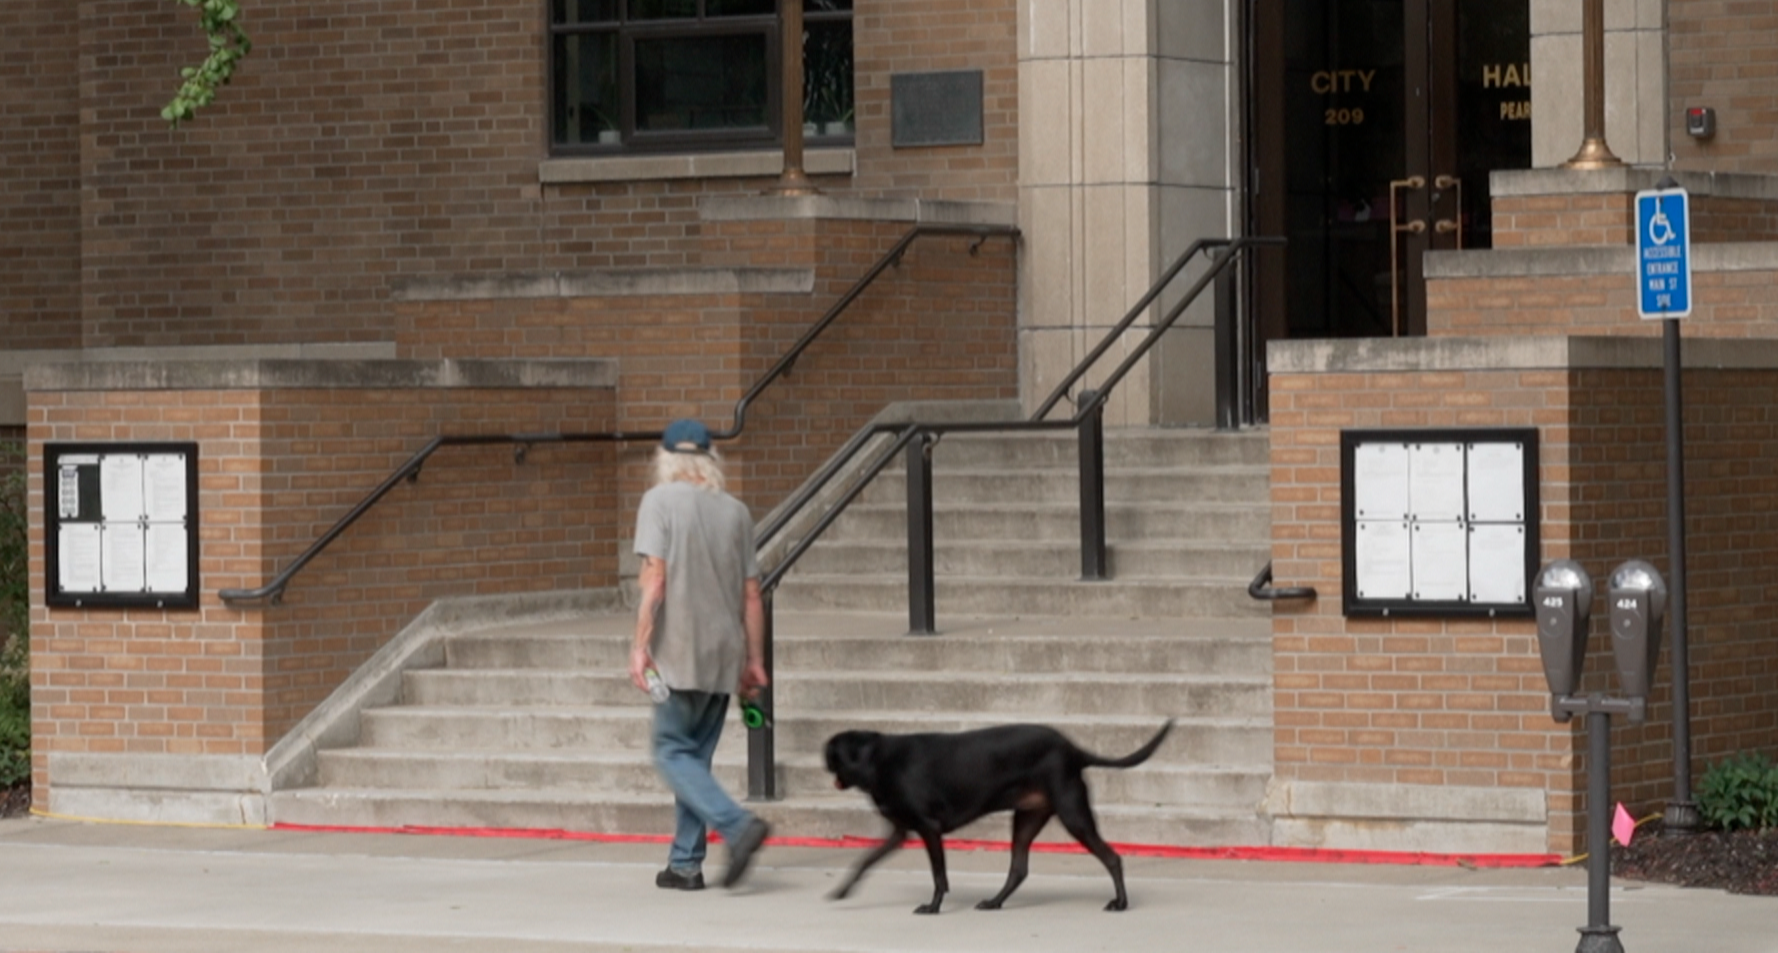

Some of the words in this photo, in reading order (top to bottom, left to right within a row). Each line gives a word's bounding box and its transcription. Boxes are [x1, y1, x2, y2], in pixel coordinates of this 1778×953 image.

[1311, 69, 1376, 93] CITY
[1325, 108, 1364, 125] 209
[1643, 245, 1682, 259] ACCESSIBLE
[1647, 261, 1679, 275] ENTRANCE
[1649, 278, 1666, 291] MAIN
[1669, 277, 1678, 290] ST
[1617, 598, 1637, 609] 424
